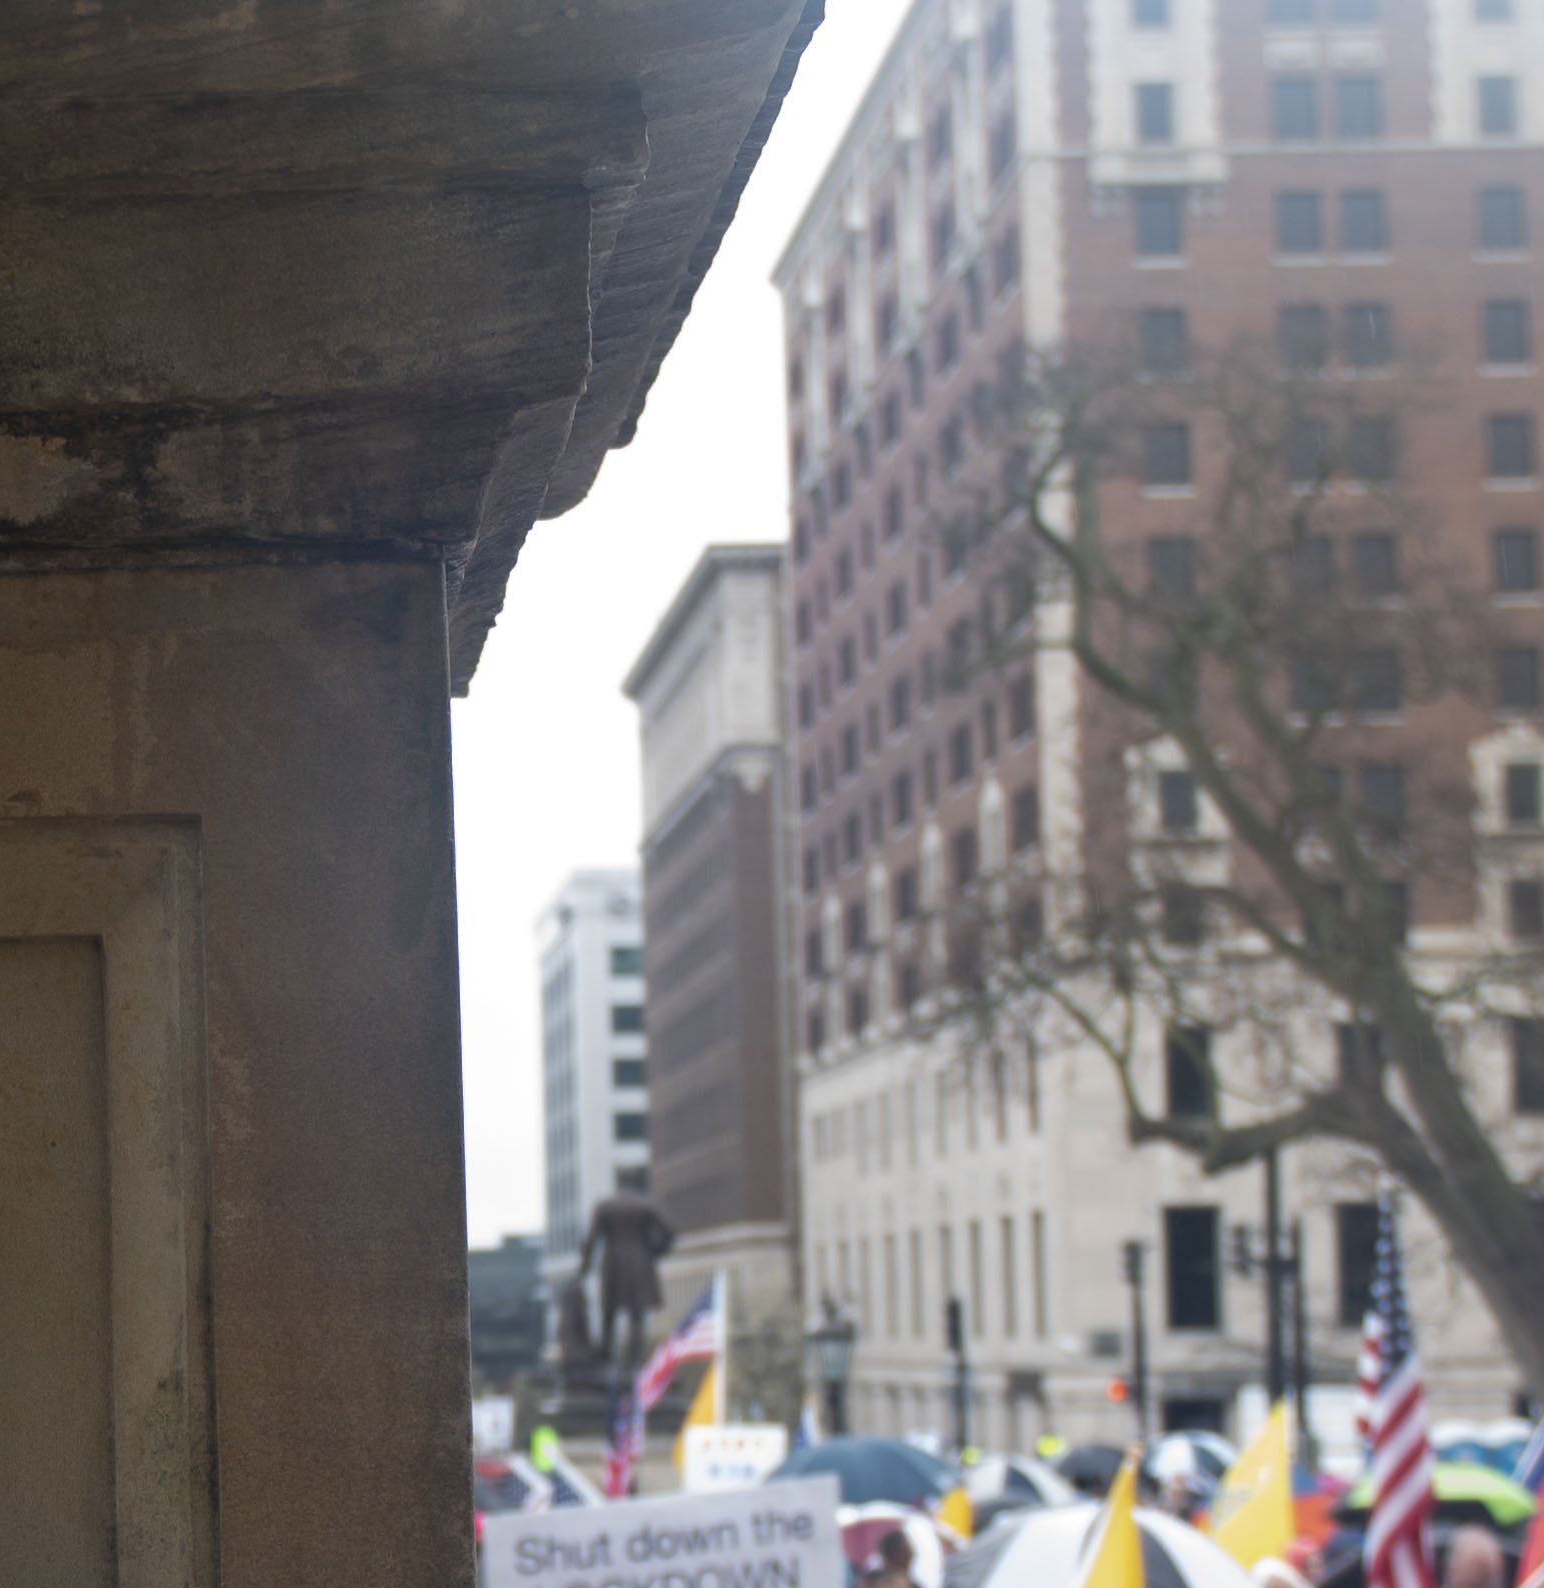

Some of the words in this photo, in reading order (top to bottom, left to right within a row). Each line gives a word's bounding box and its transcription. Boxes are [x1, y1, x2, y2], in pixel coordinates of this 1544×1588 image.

[515, 1532, 611, 1576] Shut
[625, 1519, 739, 1563] down
[751, 1508, 815, 1543] the
